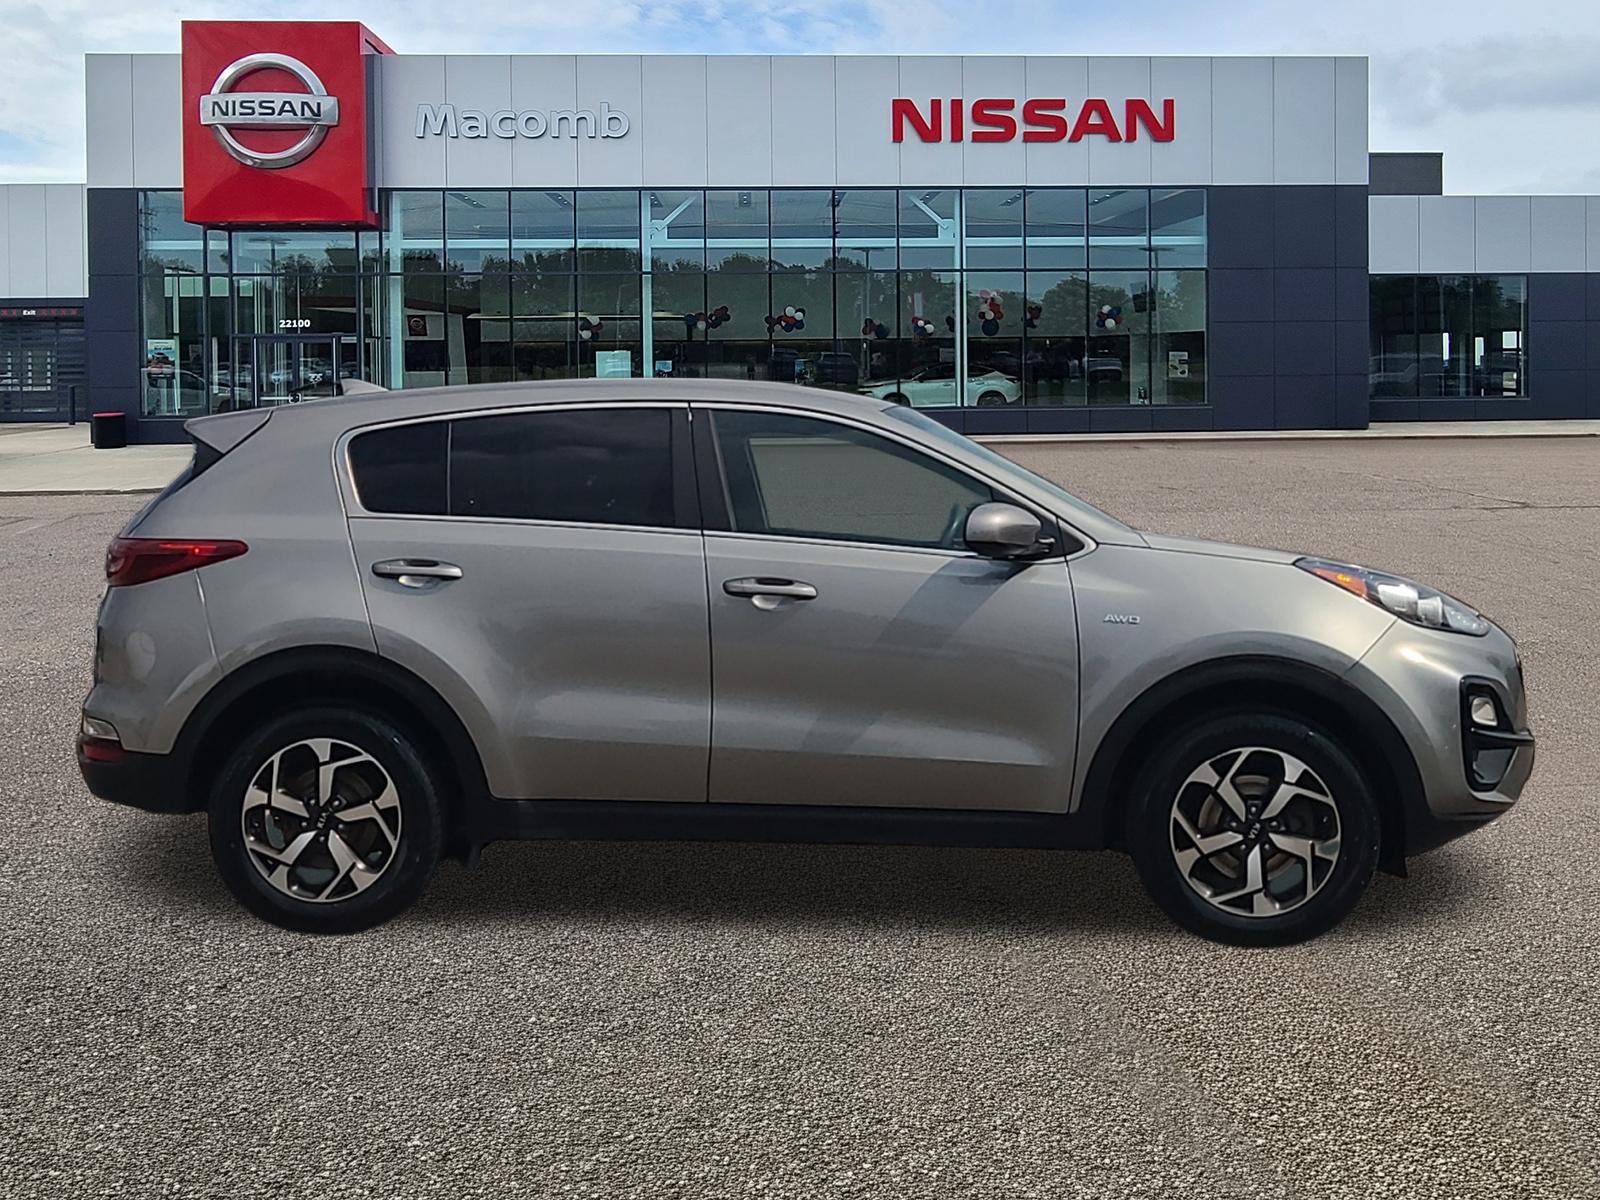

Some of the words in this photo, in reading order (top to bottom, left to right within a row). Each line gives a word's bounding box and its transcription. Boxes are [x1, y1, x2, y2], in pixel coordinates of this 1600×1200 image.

[211, 100, 322, 117] NISSAN
[415, 102, 630, 139] Macomb
[892, 98, 1175, 143] NISSAN
[280, 319, 311, 328] 22100
[1103, 614, 1140, 624] AWD
[1248, 822, 1261, 839] KIA
